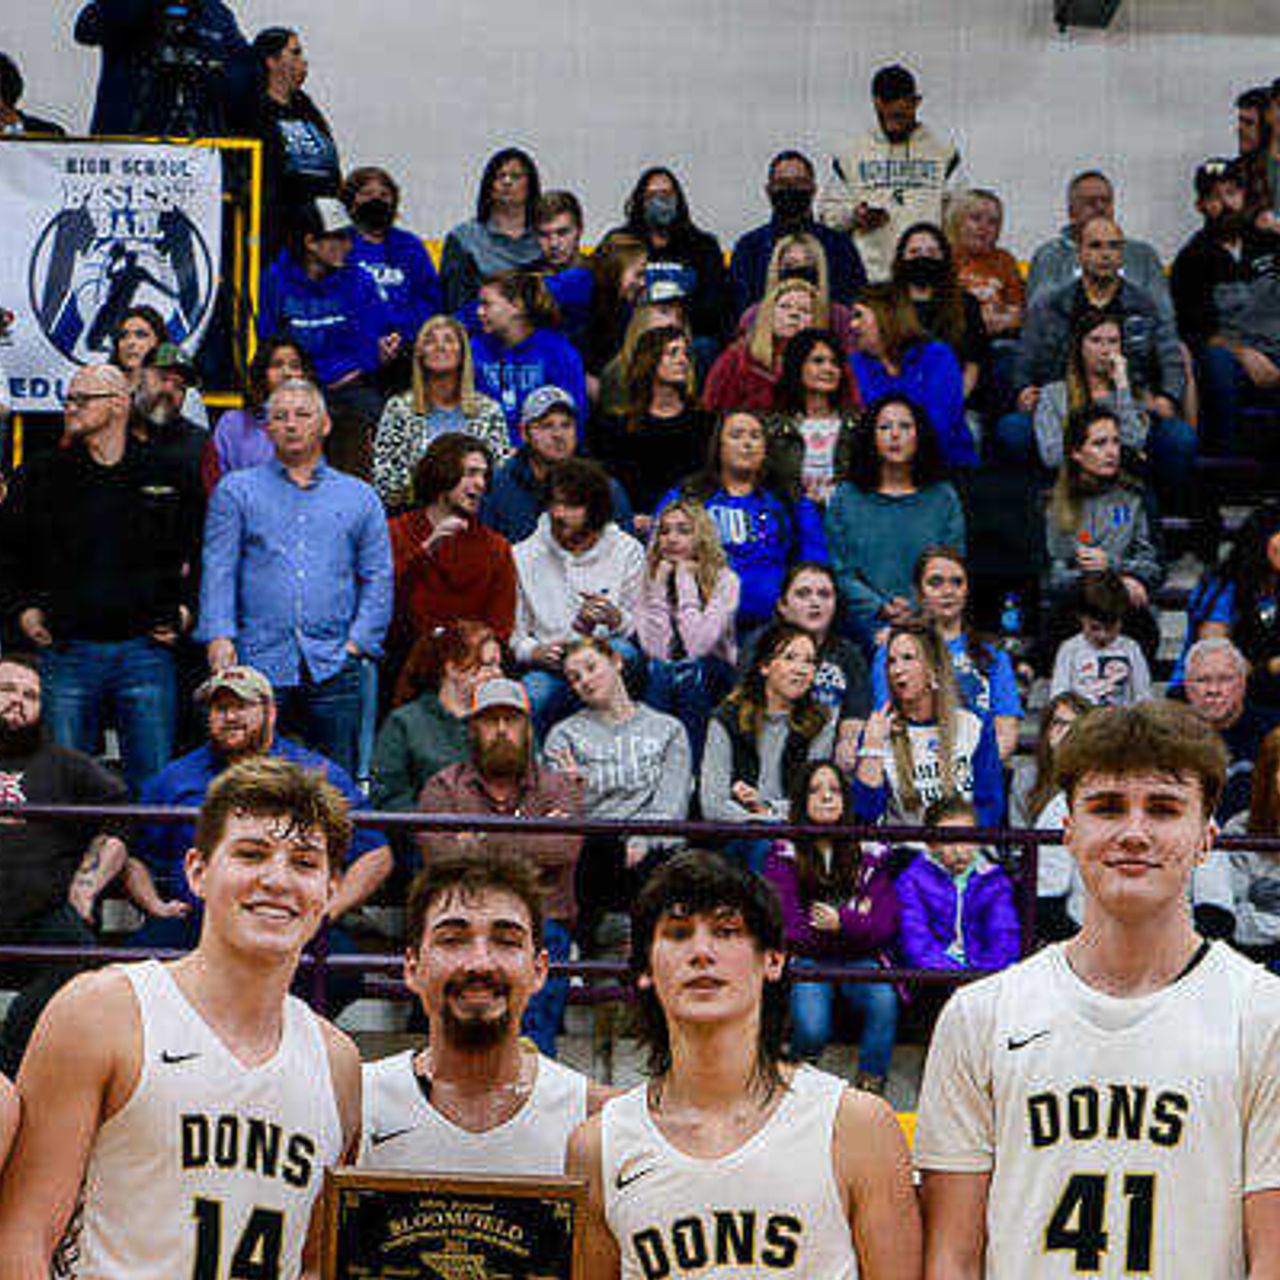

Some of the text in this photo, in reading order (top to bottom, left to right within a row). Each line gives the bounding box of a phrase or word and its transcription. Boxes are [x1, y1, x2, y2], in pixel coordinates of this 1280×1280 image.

[179, 1114, 316, 1190] DONS
[1026, 1084, 1190, 1149] DONS
[1042, 1172, 1157, 1276] 41
